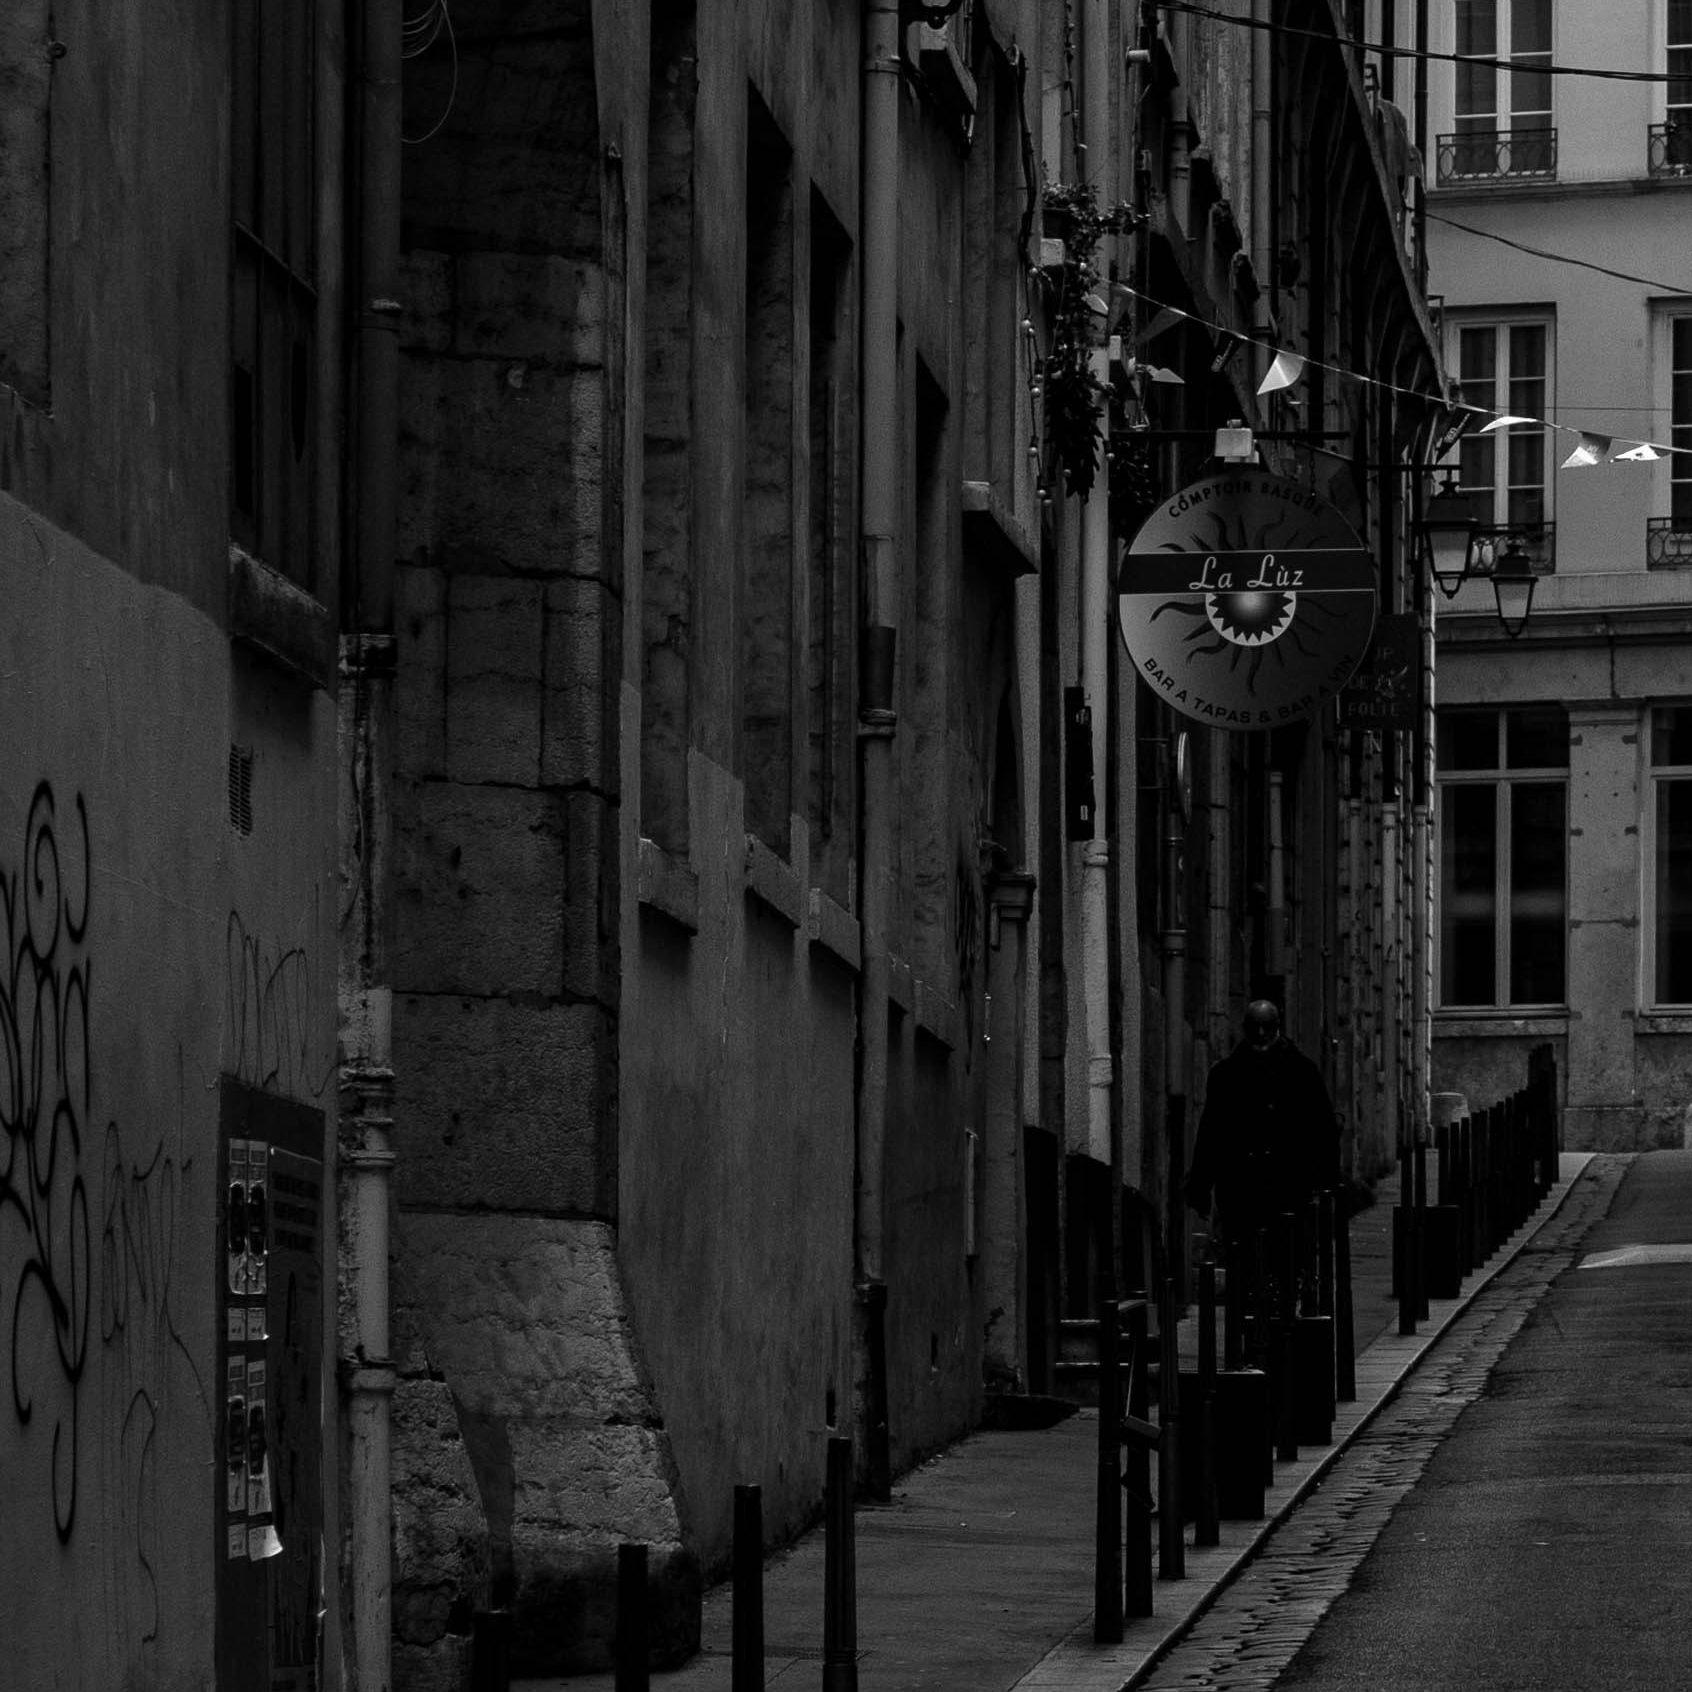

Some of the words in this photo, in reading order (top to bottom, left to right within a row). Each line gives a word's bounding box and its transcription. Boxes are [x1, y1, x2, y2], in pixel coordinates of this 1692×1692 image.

[1188, 555, 1233, 590] La
[1246, 553, 1304, 589] Lùz
[1143, 657, 1175, 691] BAR
[1193, 696, 1250, 724] TAPAS
[1258, 710, 1272, 723] &
[1278, 694, 1314, 718] BAR
[1326, 654, 1355, 682] VIN
